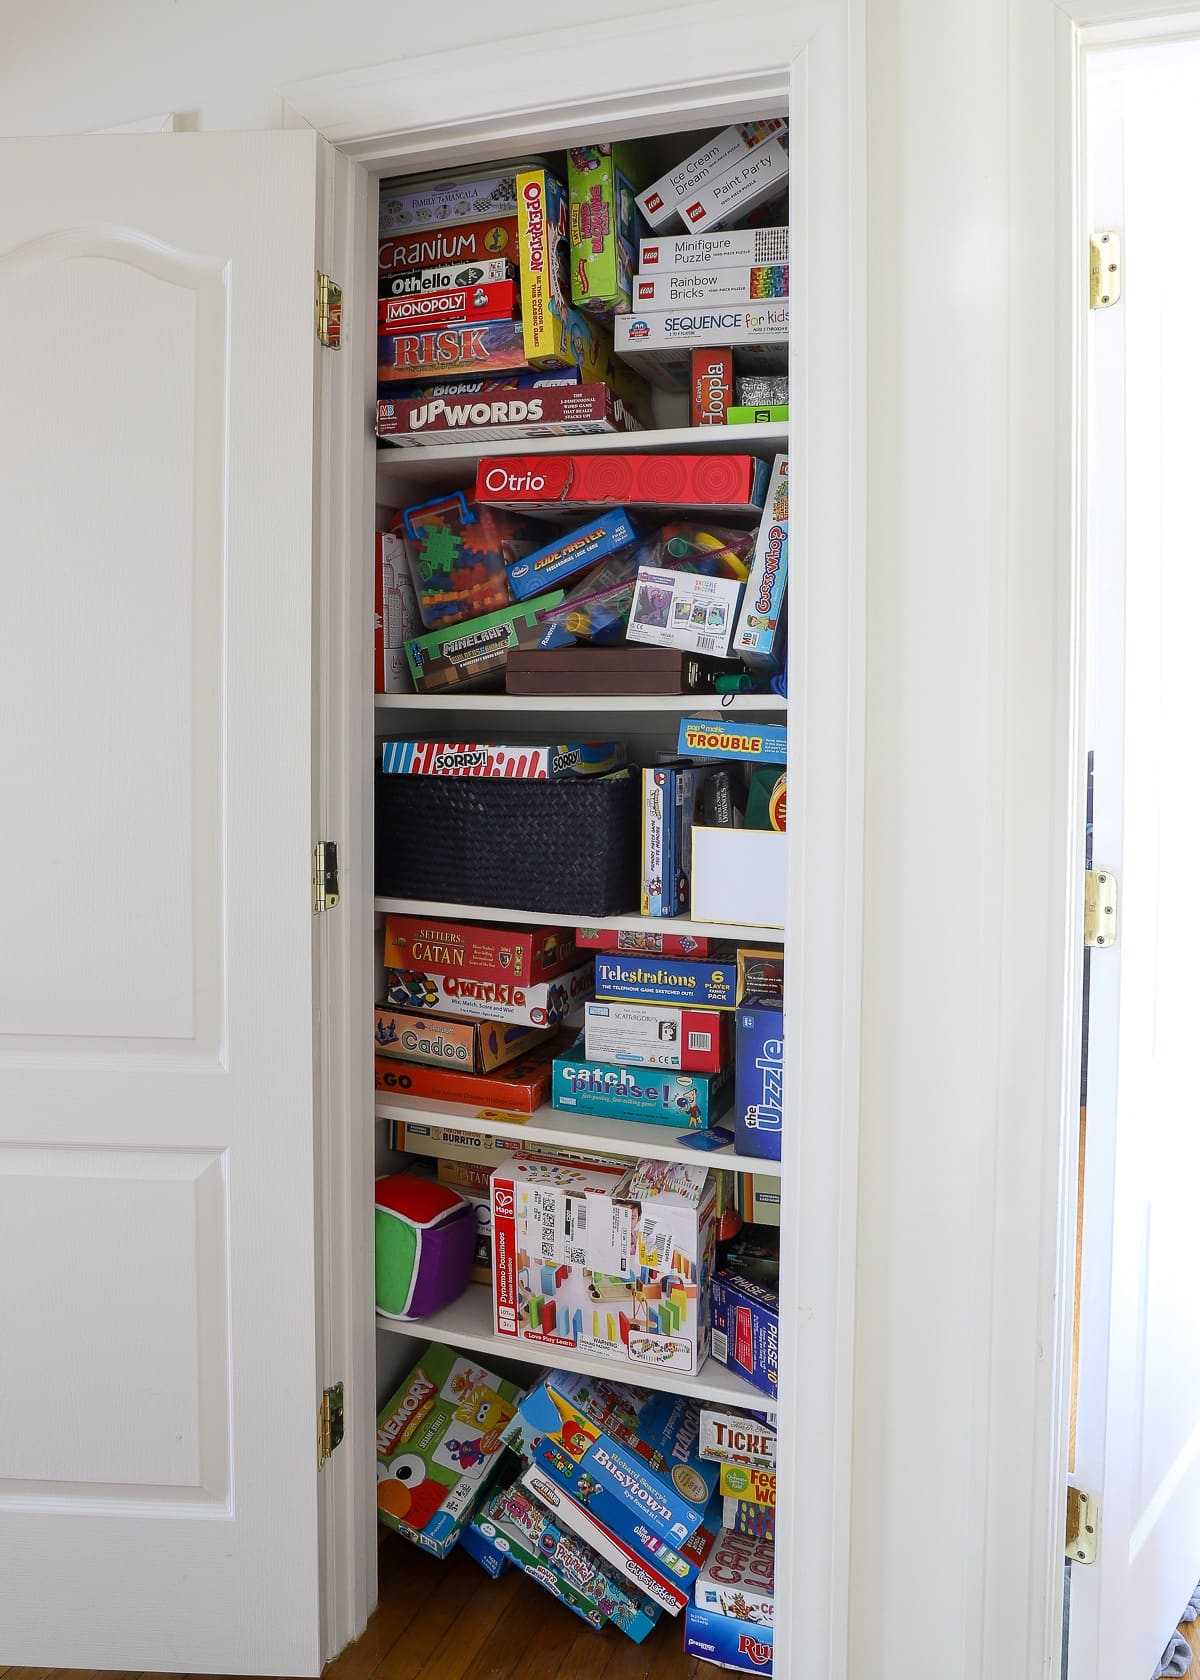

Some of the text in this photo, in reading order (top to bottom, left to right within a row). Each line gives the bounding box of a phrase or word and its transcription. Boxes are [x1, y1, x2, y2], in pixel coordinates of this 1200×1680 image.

[669, 146, 720, 186] Ice Cream
[713, 155, 773, 198] Paint Party
[675, 169, 710, 196] Dream
[648, 197, 661, 210] LEGO
[689, 206, 704, 218] LEGO
[523, 183, 543, 272] OPERATION
[675, 239, 731, 252] Minifigure
[675, 252, 711, 264] Puzzle
[391, 275, 451, 294] Othello
[640, 287, 653, 295] LEGO
[671, 276, 718, 288] Rainbow
[671, 288, 704, 299] Bricks
[390, 296, 463, 319] MONOPOLY
[665, 314, 742, 332] SEQUENCE
[745, 313, 764, 328] for
[768, 309, 789, 324] kids
[393, 328, 490, 369] RISK
[700, 362, 729, 426] Hoopla
[380, 405, 394, 416] MB
[409, 399, 543, 430] UPWORDS
[486, 468, 545, 491] Otrio
[532, 527, 607, 571] CODE MASTER
[756, 525, 788, 614] Guess Who?
[442, 623, 513, 654] MINECRAFT
[687, 733, 762, 751] TROUBLE
[436, 751, 487, 769] SORRY!
[553, 750, 581, 771] SORRY!
[419, 929, 461, 943] SETTLERS
[412, 942, 464, 967] CATAN
[600, 965, 696, 988] Telestrations
[711, 971, 724, 982] 6
[442, 976, 527, 1009] Qwirkle
[401, 1030, 468, 1060] Cadoo
[383, 1072, 413, 1089] GO
[562, 1065, 635, 1086] catch
[756, 1040, 783, 1132] Uzzle
[571, 1074, 670, 1108] phrase!
[746, 1107, 756, 1128] the
[442, 1133, 481, 1147] BURRITO
[496, 1205, 514, 1215] Hape
[729, 1275, 776, 1302] PHASE 10
[767, 1323, 777, 1384] PHASE 10
[377, 1369, 434, 1453] MEMORY
[420, 1414, 445, 1449] SESAME STREET
[713, 1421, 776, 1457] TICKE
[544, 1451, 573, 1479] MARIO
[551, 1449, 574, 1471] SUPER
[592, 1447, 673, 1520] Busytown
[611, 1452, 668, 1504] Richard Scarry's
[633, 1498, 649, 1513] found
[649, 1536, 686, 1576] LIFE
